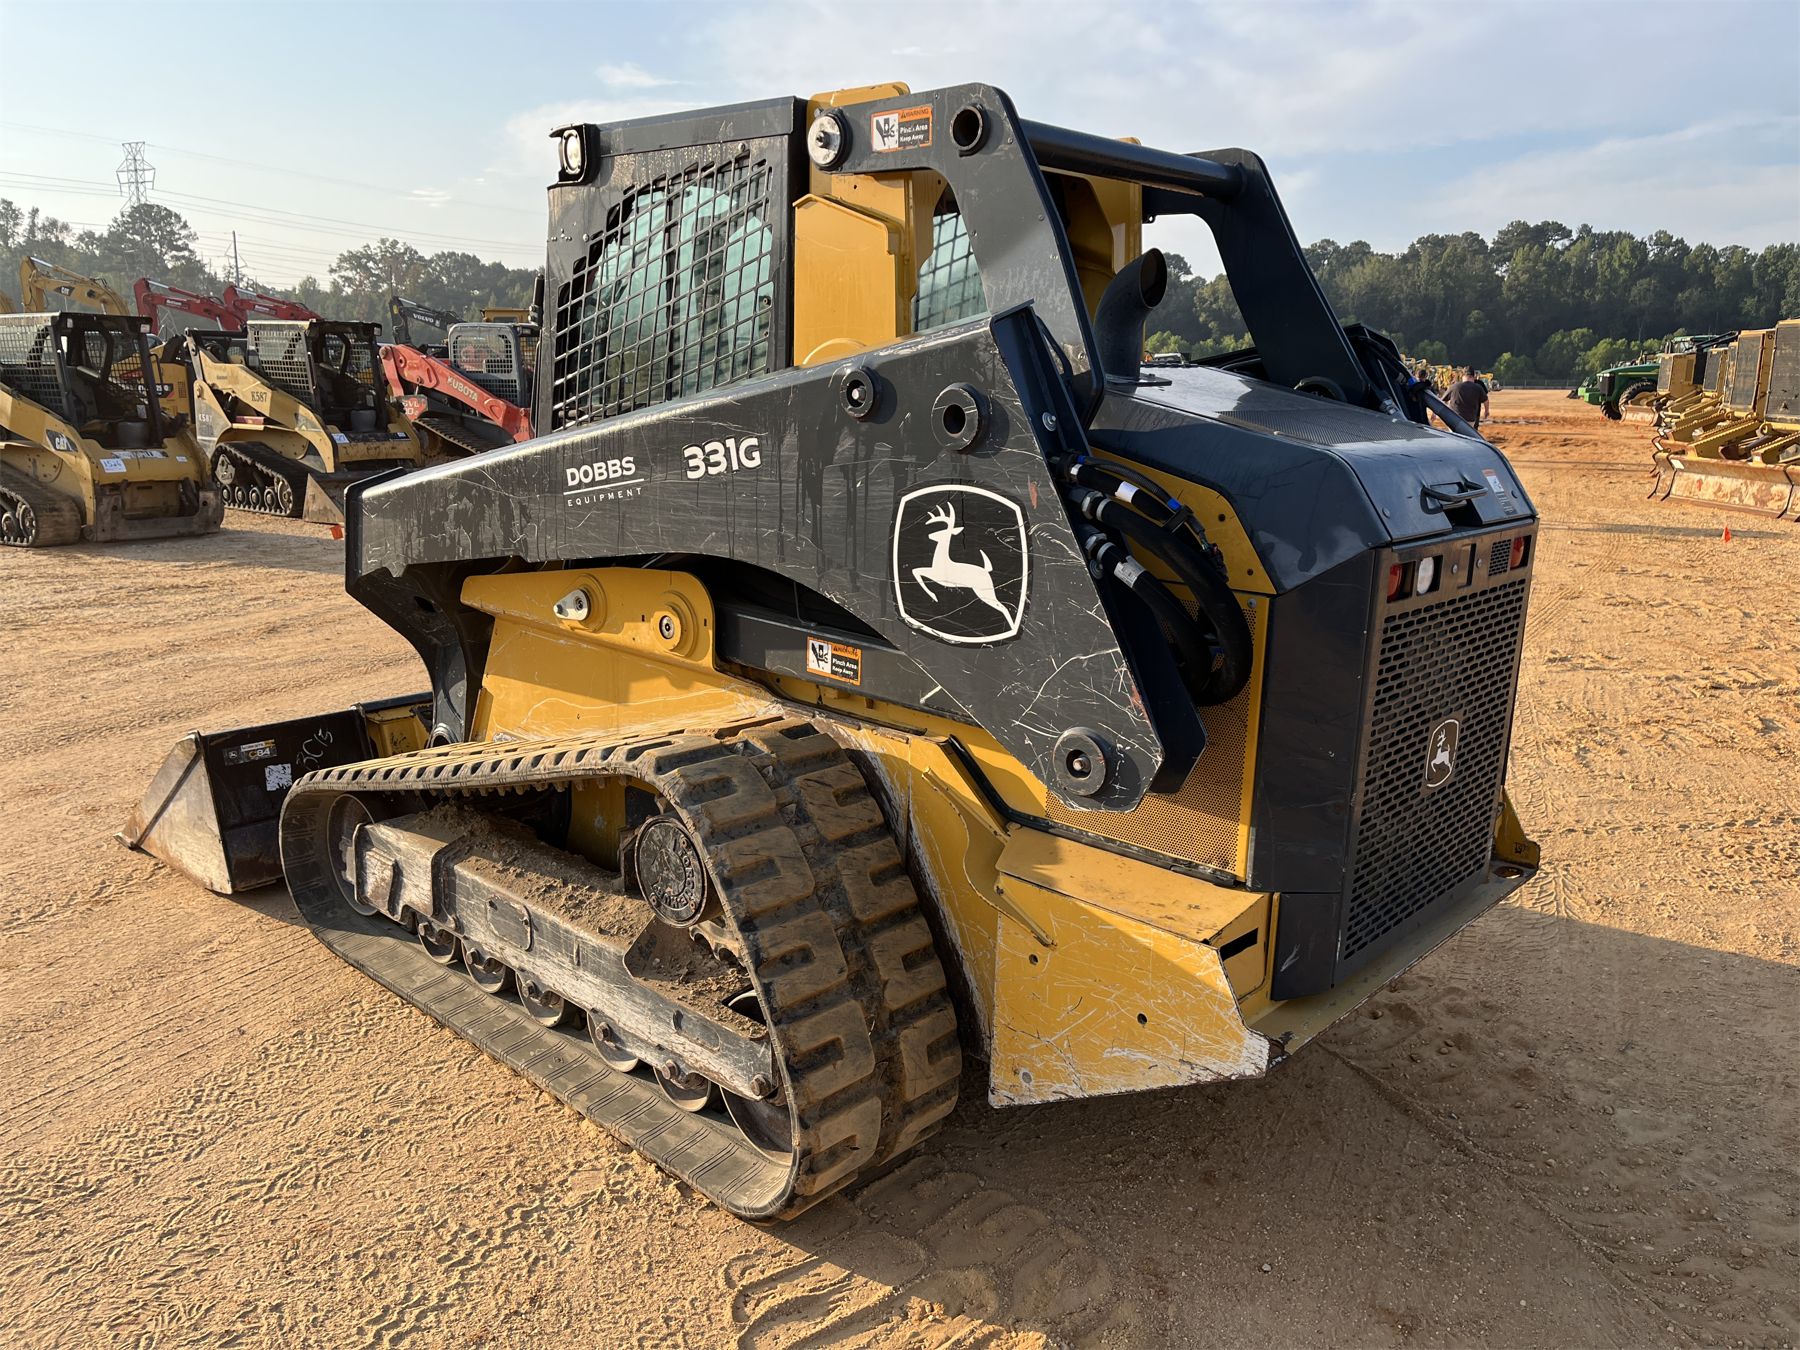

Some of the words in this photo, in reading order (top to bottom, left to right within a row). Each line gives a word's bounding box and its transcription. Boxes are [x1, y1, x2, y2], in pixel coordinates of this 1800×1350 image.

[413, 313, 434, 323] VOLVO
[447, 375, 479, 402] KUBOTA
[55, 436, 74, 452] CAT
[683, 436, 763, 480] 331G
[566, 456, 637, 487] DOBBS
[567, 487, 643, 507] EQUIPMENT
